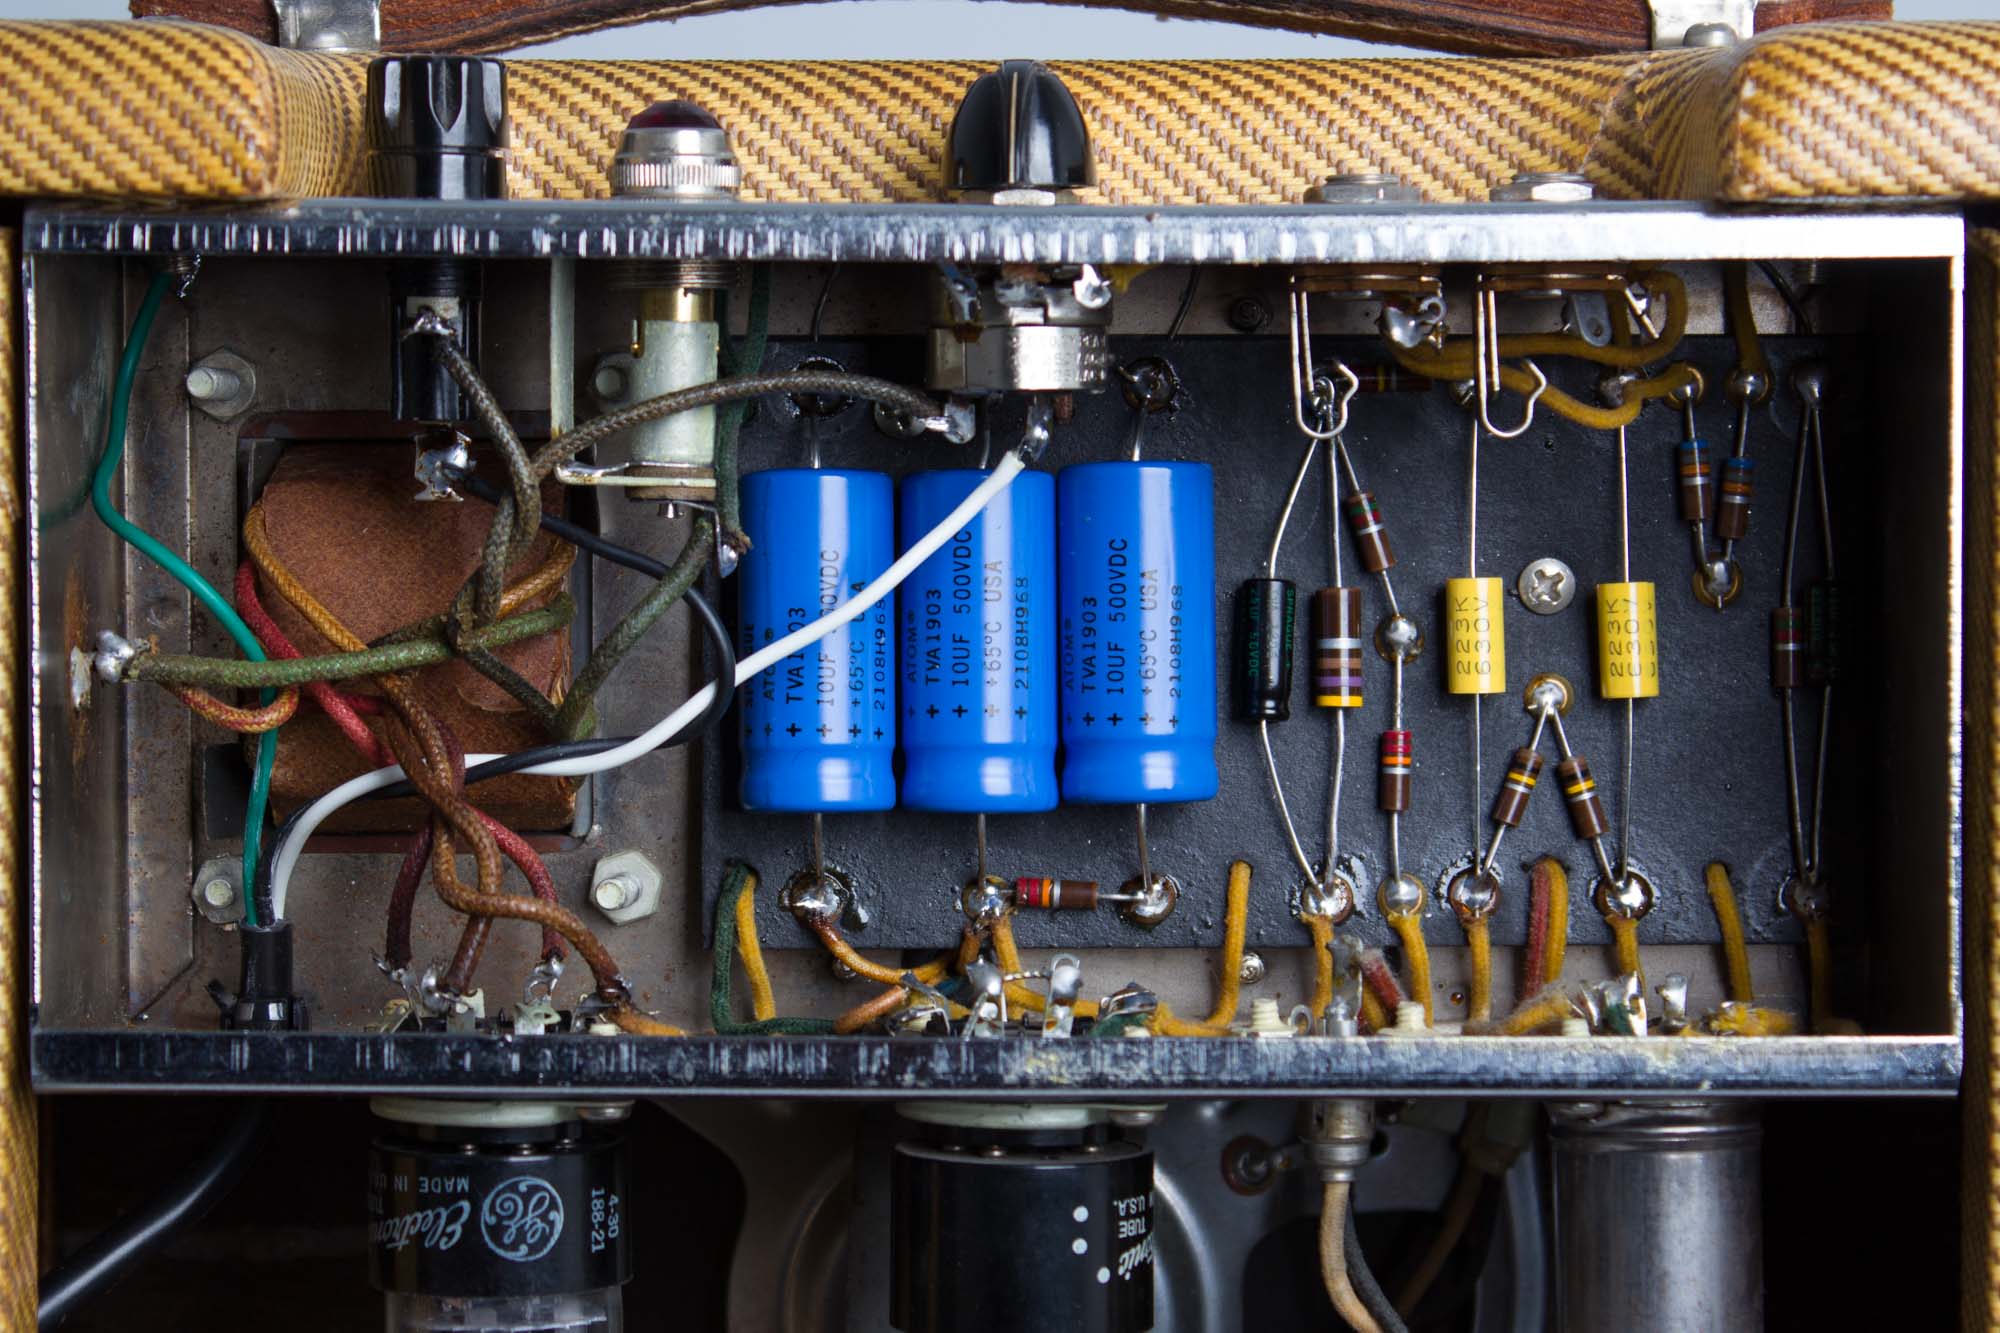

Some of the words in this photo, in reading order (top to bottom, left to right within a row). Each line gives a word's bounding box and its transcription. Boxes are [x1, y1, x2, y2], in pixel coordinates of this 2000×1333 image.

[820, 550, 839, 634] 00VDC
[953, 529, 972, 614] 500VDC
[984, 560, 1002, 603] USA
[1109, 538, 1128, 622] 500VDC
[1139, 569, 1157, 611] USA
[786, 608, 805, 704] TVA103
[926, 589, 941, 686] TVA1903
[952, 632, 970, 687] 10UF
[1015, 576, 1029, 690] 2108H968
[1081, 597, 1097, 694] TVA1903
[1107, 641, 1125, 695] 10UF
[1169, 584, 1182, 699] 2108H968
[1455, 597, 1471, 676] 223K
[1473, 596, 1491, 676] 630V
[1606, 598, 1624, 678] 223K
[816, 651, 835, 706] 10UF
[392, 1176, 408, 1192] IN
[418, 1176, 470, 1193] MADE
[591, 1187, 605, 1253] 188-21
[1119, 1216, 1146, 1238] TUBE
